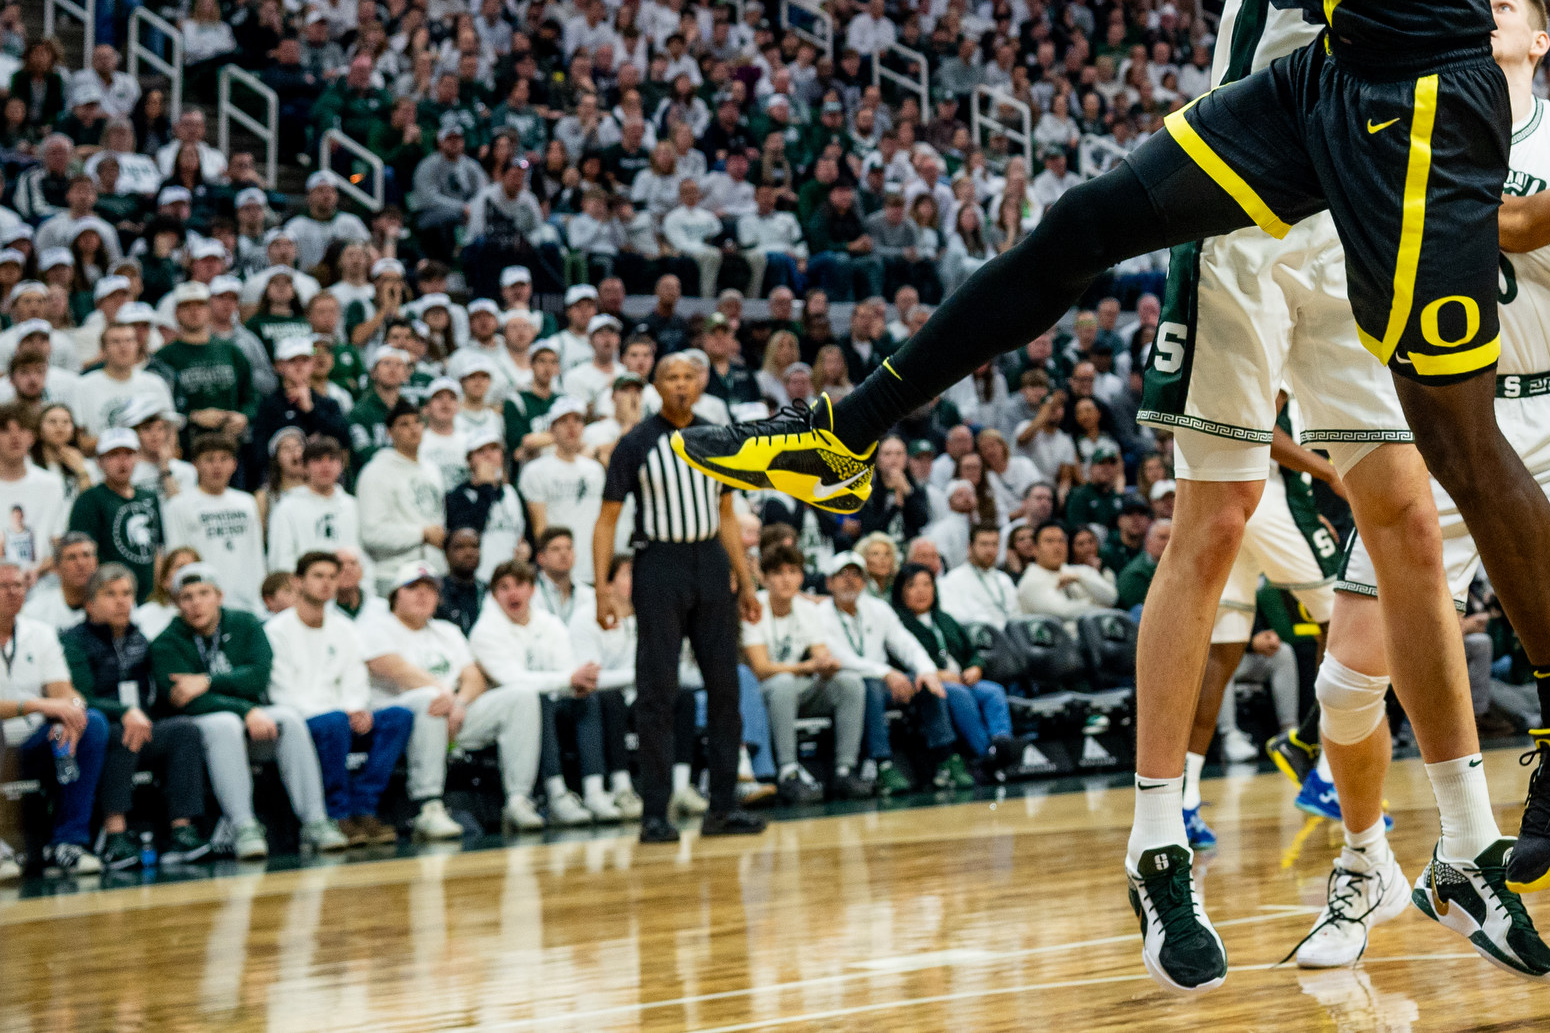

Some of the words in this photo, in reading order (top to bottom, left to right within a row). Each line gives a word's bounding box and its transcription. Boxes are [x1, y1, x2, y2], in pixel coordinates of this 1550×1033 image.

[1420, 294, 1480, 348] O
[1154, 321, 1188, 373] S
[1504, 375, 1521, 397] S
[1312, 528, 1336, 558] S
